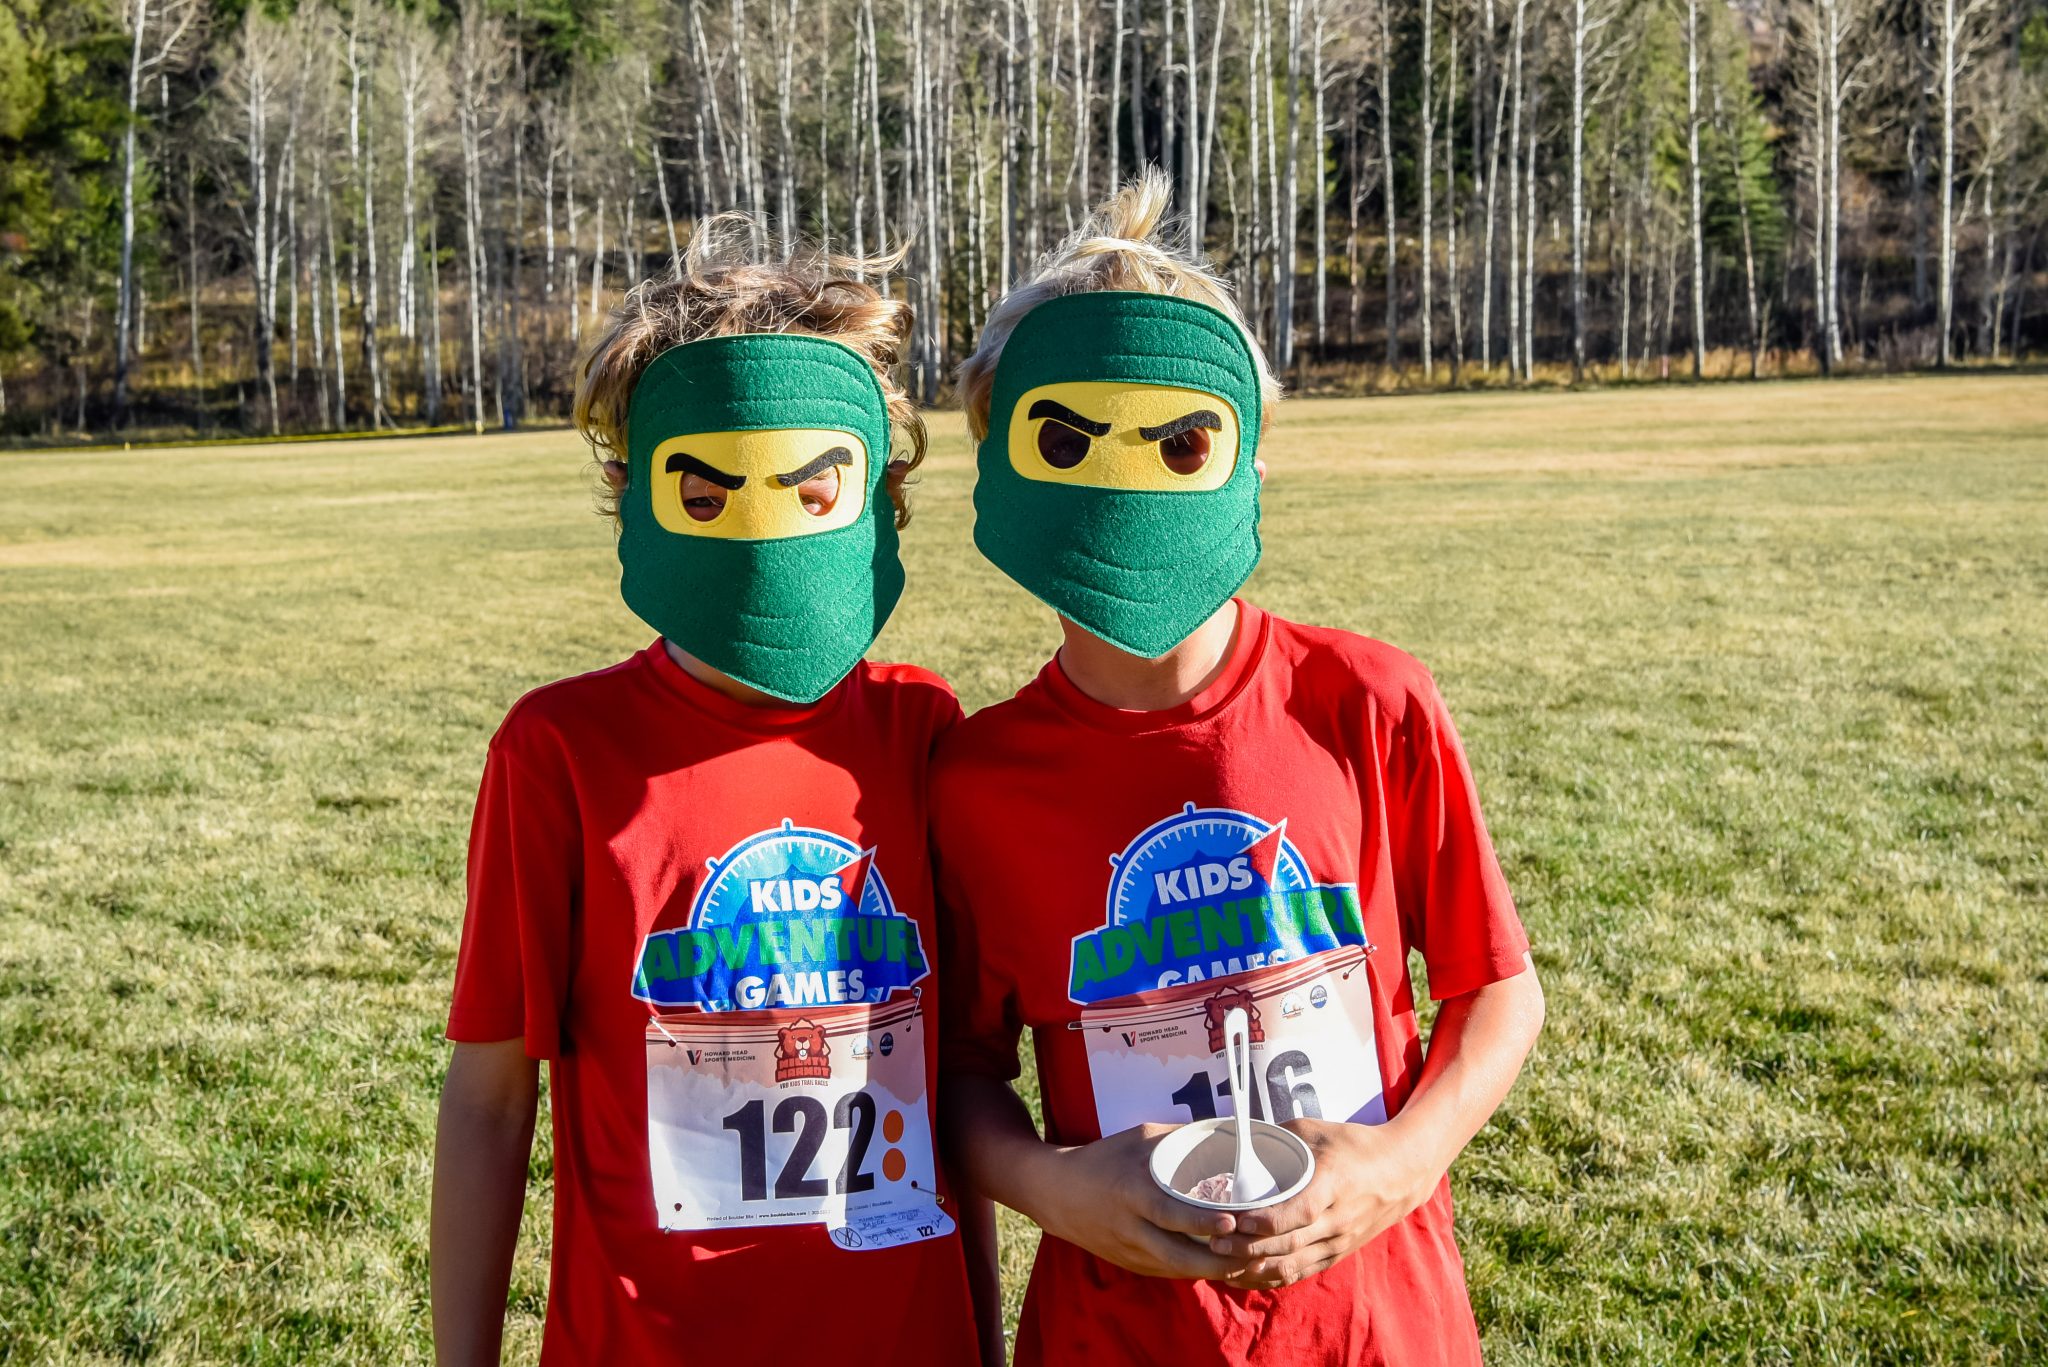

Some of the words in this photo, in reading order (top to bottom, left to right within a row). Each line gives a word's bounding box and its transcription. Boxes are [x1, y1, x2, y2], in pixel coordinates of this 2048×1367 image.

[750, 877, 842, 913] KIDS
[1155, 857, 1252, 905] KIDS
[735, 969, 865, 1009] GAMES
[1138, 1028, 1162, 1037] HOWARD
[1140, 1034, 1160, 1043] SPORTS
[1161, 1030, 1188, 1039] MEDICINE
[722, 1091, 877, 1202] 122
[917, 1225, 936, 1238] 122
